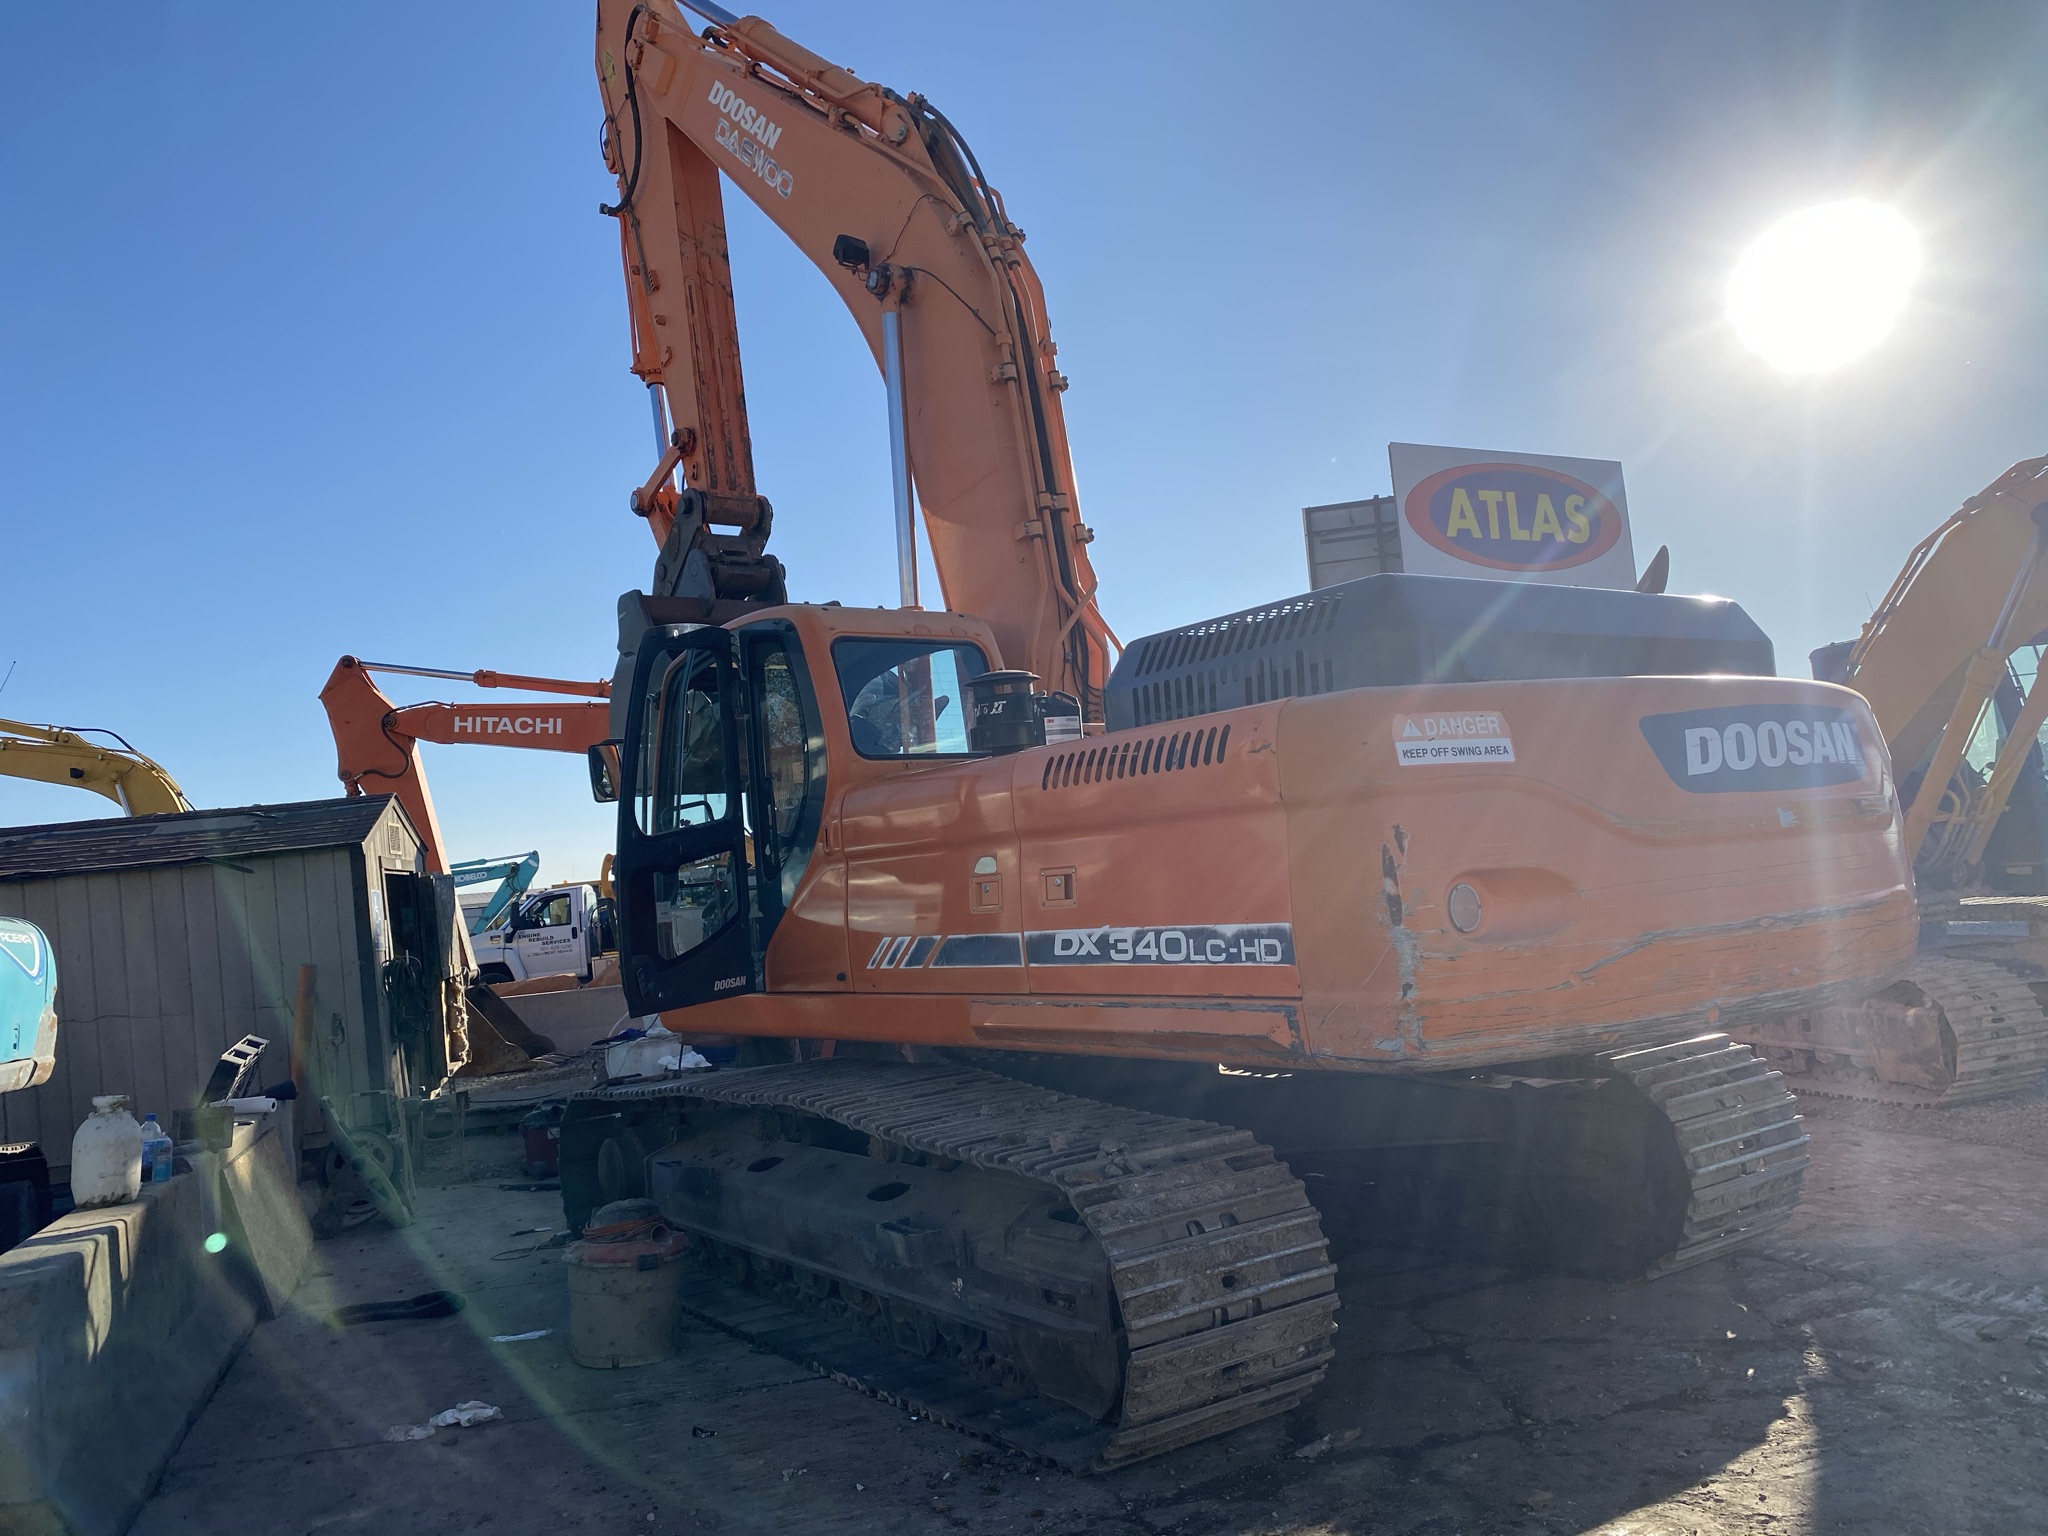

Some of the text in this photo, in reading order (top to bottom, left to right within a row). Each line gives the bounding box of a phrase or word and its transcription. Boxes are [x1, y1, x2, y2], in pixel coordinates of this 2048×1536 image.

[707, 79, 783, 151] DOOSAN
[714, 117, 794, 199] DAEWOO
[1446, 487, 1591, 544] ATLAS
[453, 716, 562, 735] HITACHI
[1423, 716, 1502, 736] DANGER
[1402, 745, 1510, 759] KEEP OFF SWING AREA
[1684, 720, 1857, 776] DOOSAN
[454, 871, 488, 883] KOBELCO
[518, 932, 541, 940] ENGINE
[528, 935, 554, 943] REBUILD
[541, 938, 571, 946] SERVICES
[714, 975, 747, 991] DOOSAN
